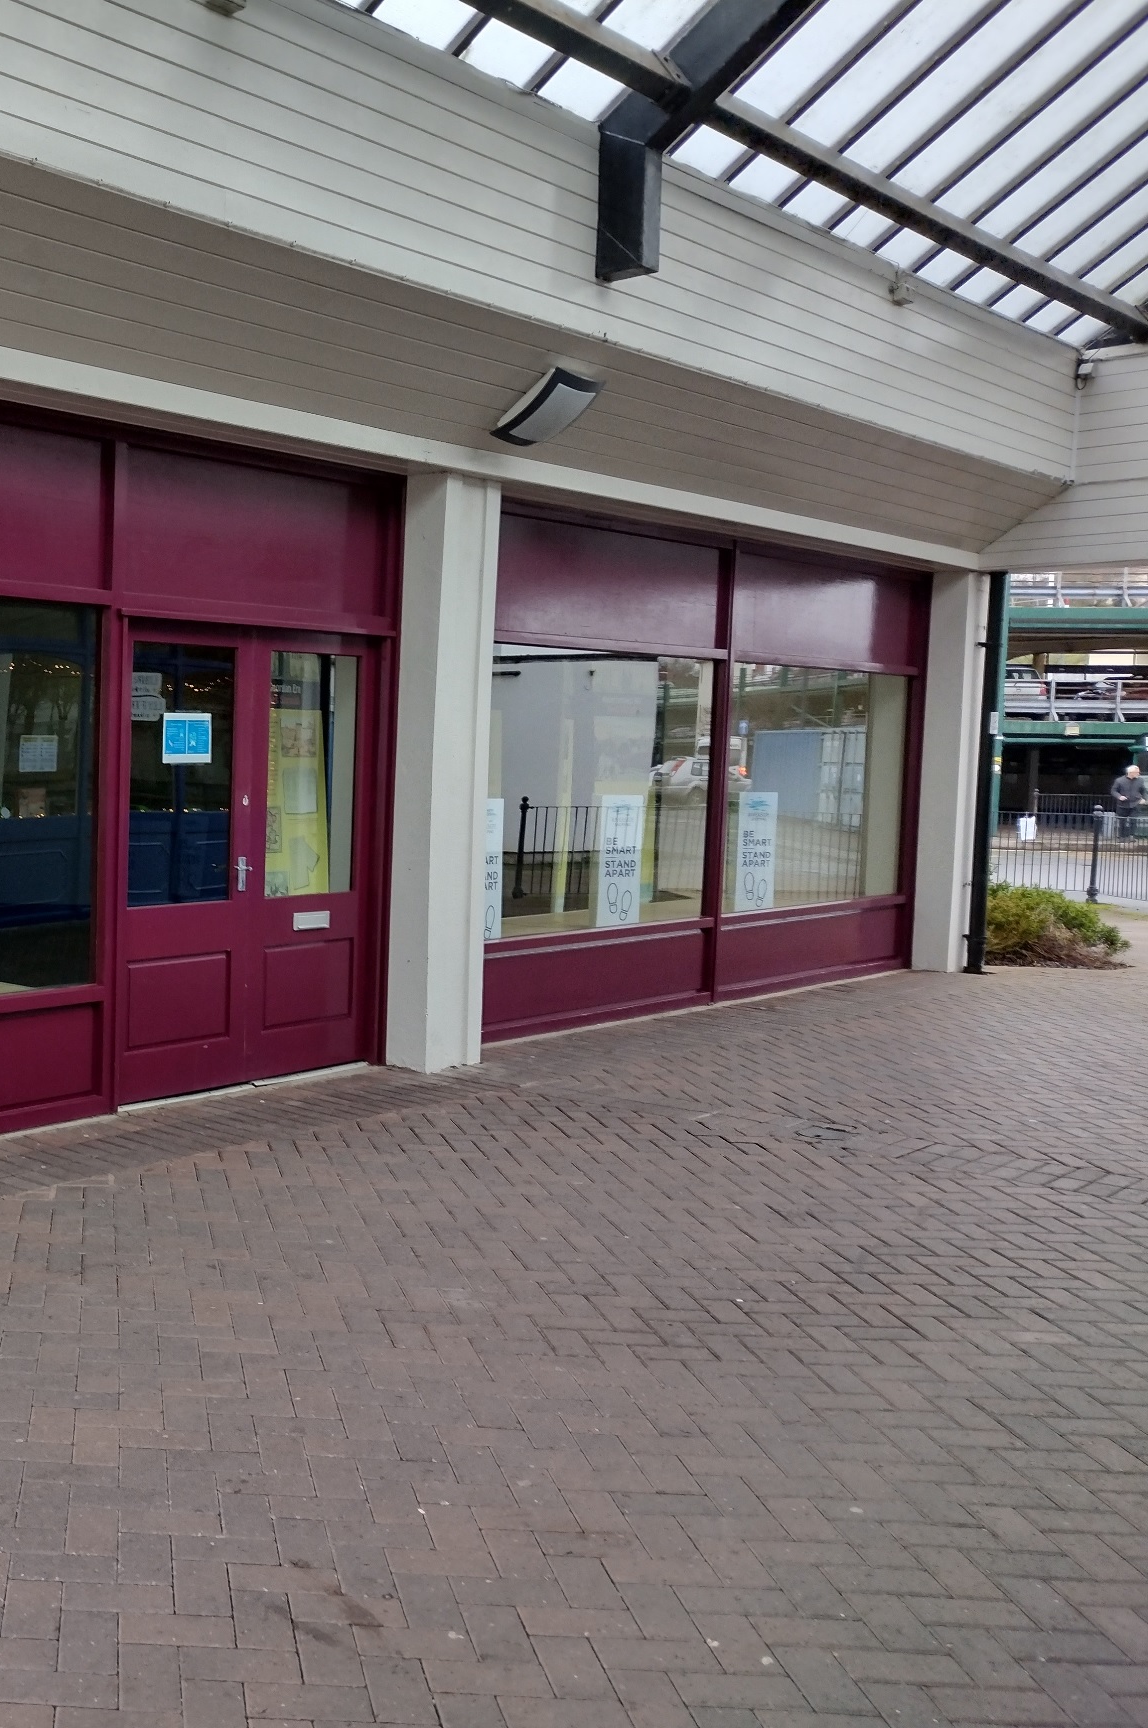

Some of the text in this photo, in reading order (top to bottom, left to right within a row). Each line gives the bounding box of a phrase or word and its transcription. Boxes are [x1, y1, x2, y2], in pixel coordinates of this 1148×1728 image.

[742, 830, 754, 838] BE
[606, 837, 618, 846] BE
[742, 838, 772, 846] SMART
[605, 845, 637, 855] SMART
[742, 851, 771, 859] STAND
[604, 859, 637, 869] STAND
[741, 859, 770, 868] APART
[604, 869, 636, 878] APART
